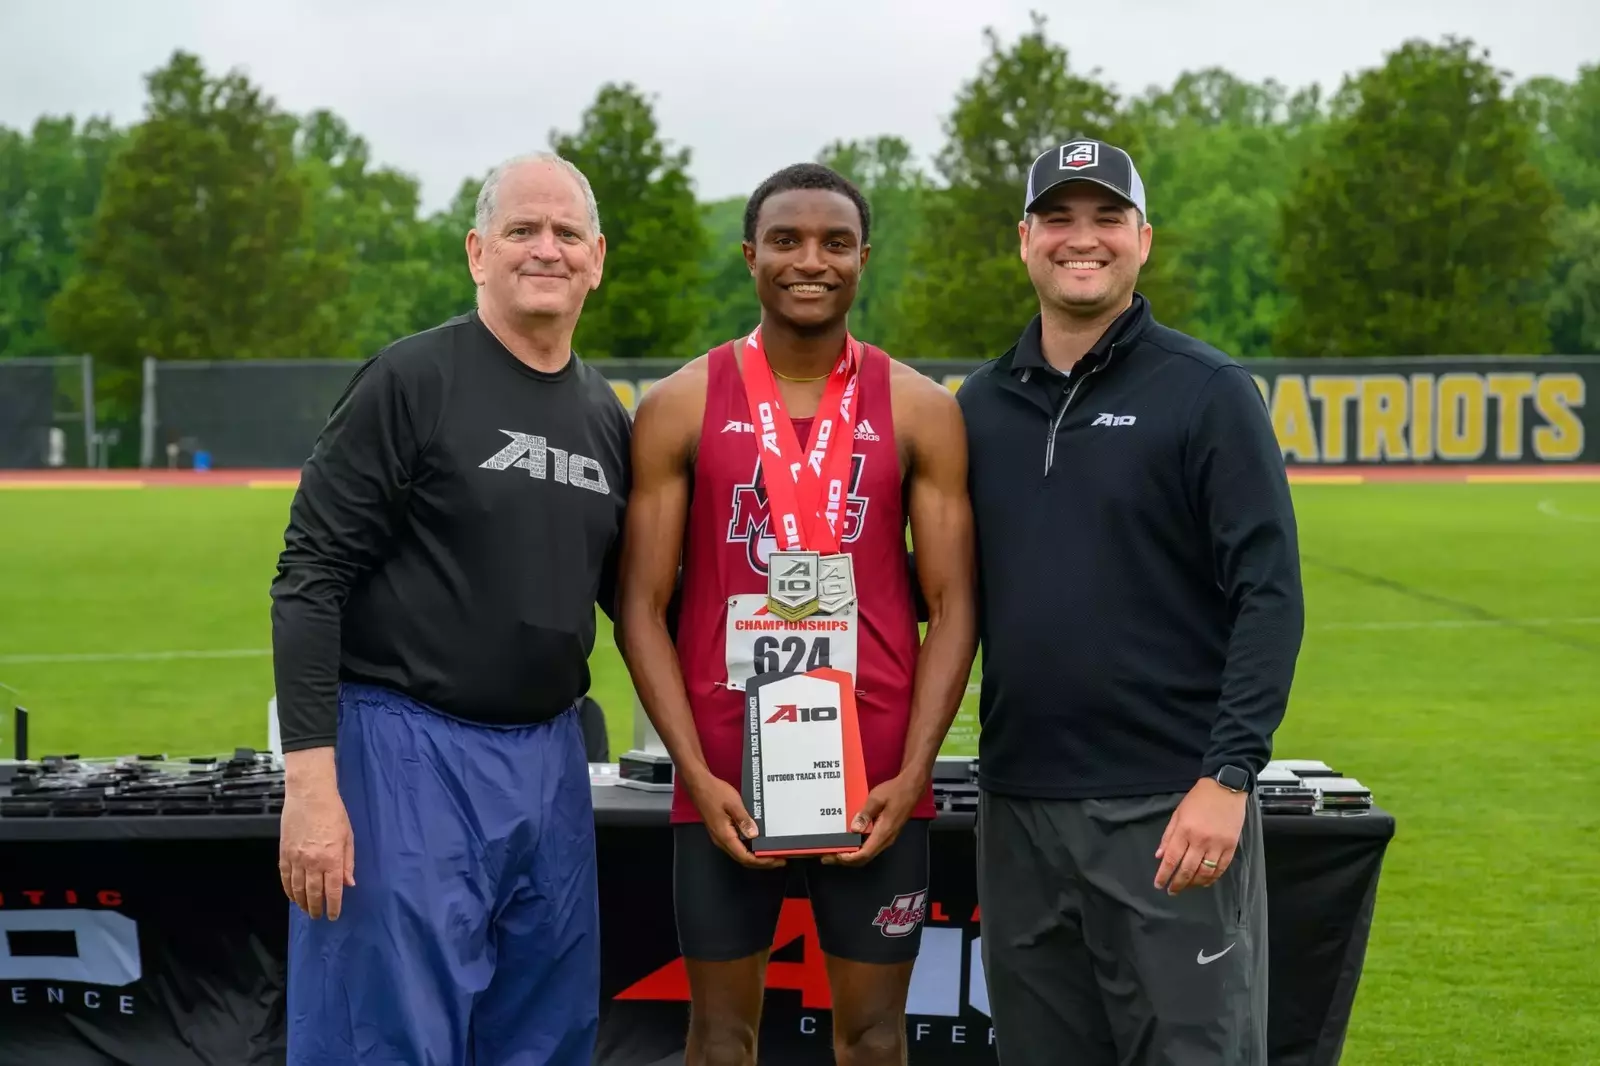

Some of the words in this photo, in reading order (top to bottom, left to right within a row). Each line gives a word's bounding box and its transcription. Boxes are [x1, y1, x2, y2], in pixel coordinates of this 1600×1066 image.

[1091, 413, 1136, 426] A10
[1254, 372, 1586, 462] ATRIOTS
[758, 402, 781, 458] A10
[854, 432, 880, 442] adidas
[808, 420, 832, 477] A10
[478, 429, 610, 495] A10
[735, 620, 848, 631] CHAMPIONSHIPS
[753, 636, 832, 675] 624
[749, 696, 758, 733] PERFORMER
[764, 705, 837, 724] A10
[751, 734, 759, 756] TRACK
[813, 760, 840, 769] MEN'S
[752, 757, 761, 800] OUTSTANDING
[766, 774, 795, 782] OUTDOOR
[796, 772, 816, 780] TRACK
[823, 771, 841, 779] FIELD
[754, 801, 762, 820] MOST
[820, 808, 842, 816] 2024
[11, 986, 134, 1015] ENCE
